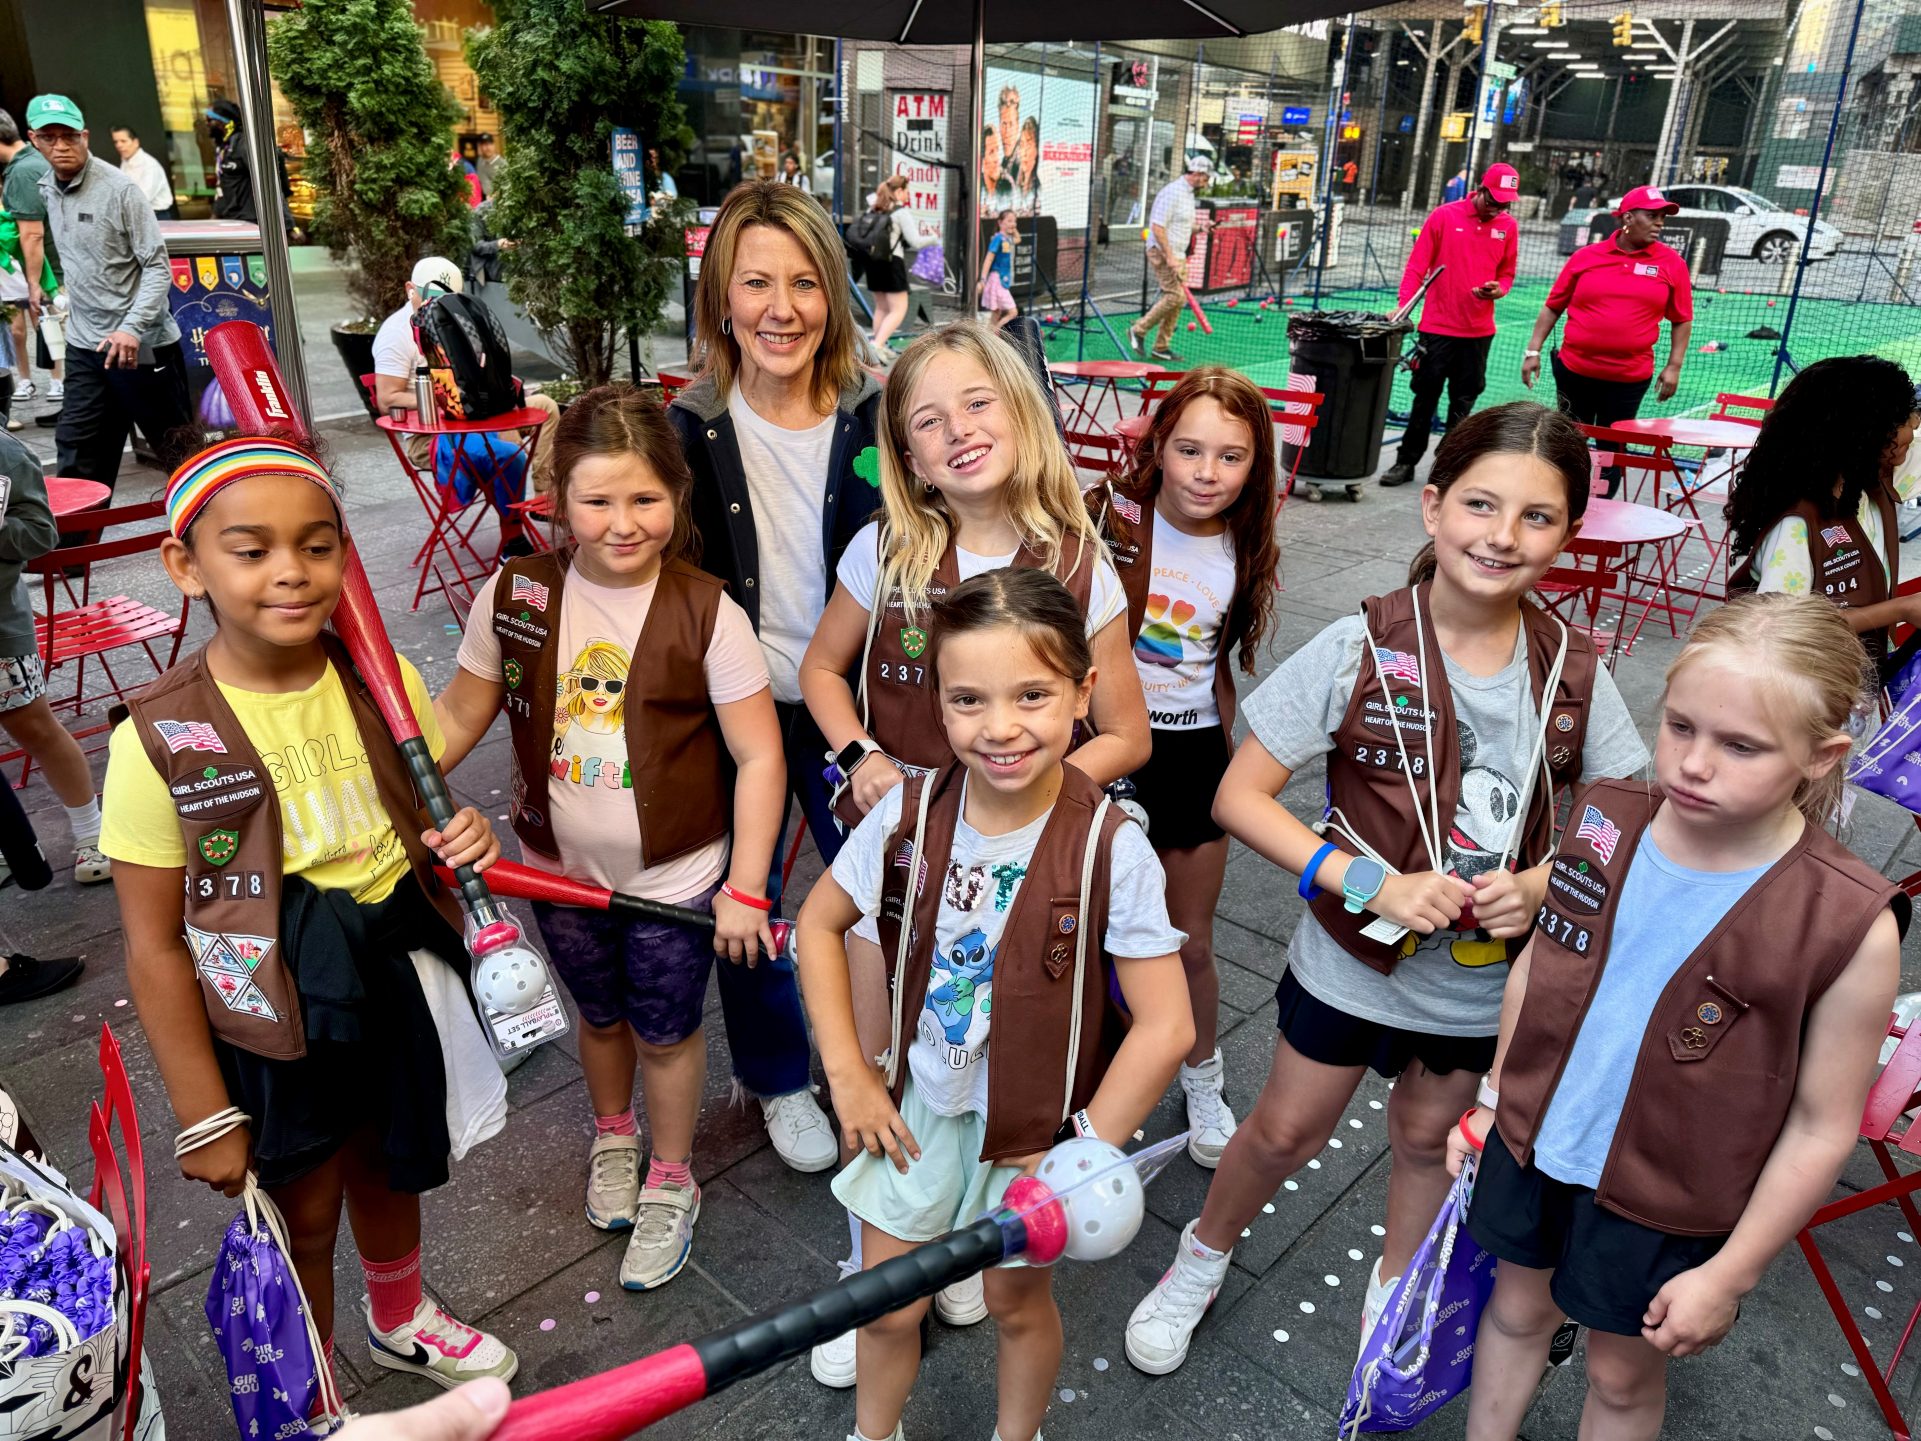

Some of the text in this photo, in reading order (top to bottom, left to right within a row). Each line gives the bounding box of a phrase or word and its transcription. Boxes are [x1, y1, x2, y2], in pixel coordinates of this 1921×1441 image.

[897, 95, 944, 117] ATM
[615, 134, 638, 150] BEER
[897, 131, 943, 152] Drink
[896, 161, 941, 187] Candy
[254, 369, 289, 419] Franklin
[1153, 567, 1221, 609] PEACE LOVE
[1826, 578, 1857, 595] 904
[496, 612, 548, 637] GIRL SCOUTS USA
[514, 634, 523, 642] THE
[522, 637, 542, 648] HUDSON
[881, 663, 923, 684] 237
[1141, 681, 1169, 693] UITY
[507, 693, 530, 718] 378
[1366, 702, 1384, 711] GIRL
[1385, 706, 1418, 716] SCOUTS
[1148, 708, 1198, 726] worth
[1365, 716, 1385, 725] HEART
[1355, 747, 1424, 774] 2378
[172, 770, 256, 795] GIRL SCOUTS USA
[549, 755, 633, 789] wifti
[180, 787, 260, 813] HEART OF THE HUDSON
[945, 858, 1027, 913] UT
[1555, 861, 1606, 896] GIRL SCOUTS USA
[1550, 875, 1564, 889] HEART
[1570, 886, 1579, 898] THE
[1578, 892, 1600, 909] HUDSON
[1539, 906, 1588, 951] 2378
[507, 1024, 521, 1035] SET
[1434, 1298, 1470, 1328] SCOUTS
[1438, 1300, 1458, 1318] GIRL
[254, 1343, 273, 1356] GIR
[234, 1374, 257, 1386] GIR
[274, 1422, 308, 1441] SCOU
